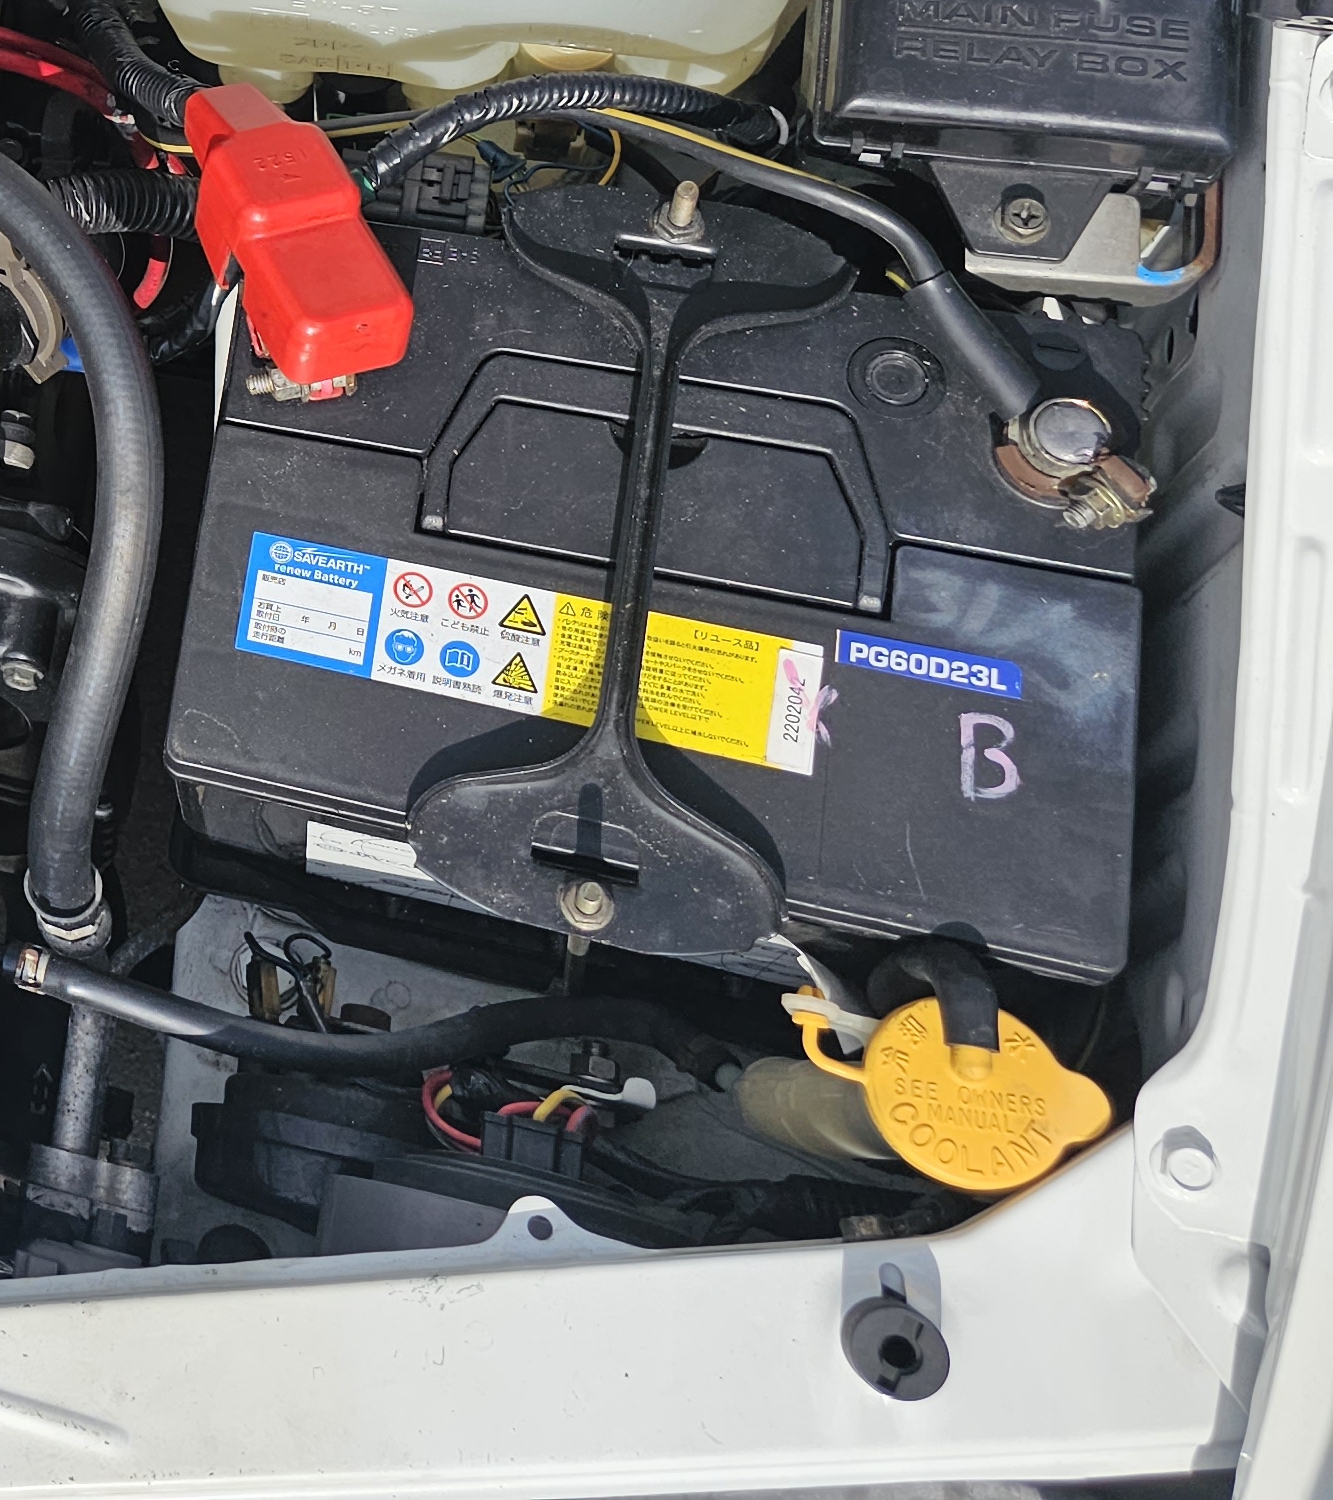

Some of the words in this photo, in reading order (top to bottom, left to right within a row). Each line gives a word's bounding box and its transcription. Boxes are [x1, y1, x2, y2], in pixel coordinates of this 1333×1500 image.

[896, 0, 1035, 28] MAIN
[1054, 10, 1191, 42] FUSE
[894, 36, 1059, 69] RELAY
[1074, 51, 1189, 82] BOX
[273, 562, 311, 578] renew
[312, 569, 358, 589] Battery
[300, 615, 309, 623] 年
[328, 621, 336, 630] 月
[356, 627, 364, 636] 日
[389, 607, 429, 623] 火気注意
[440, 617, 490, 636] こども禁止
[348, 648, 361, 656] km
[849, 641, 1007, 691] PG60D23L
[376, 663, 425, 682] メガネ着用
[959, 712, 1022, 801] B
[895, 1077, 937, 1101] SEE
[957, 1086, 1046, 1117] OWNERS
[927, 1102, 1018, 1136] MANUAL
[889, 1102, 1054, 1177] COOLANT
